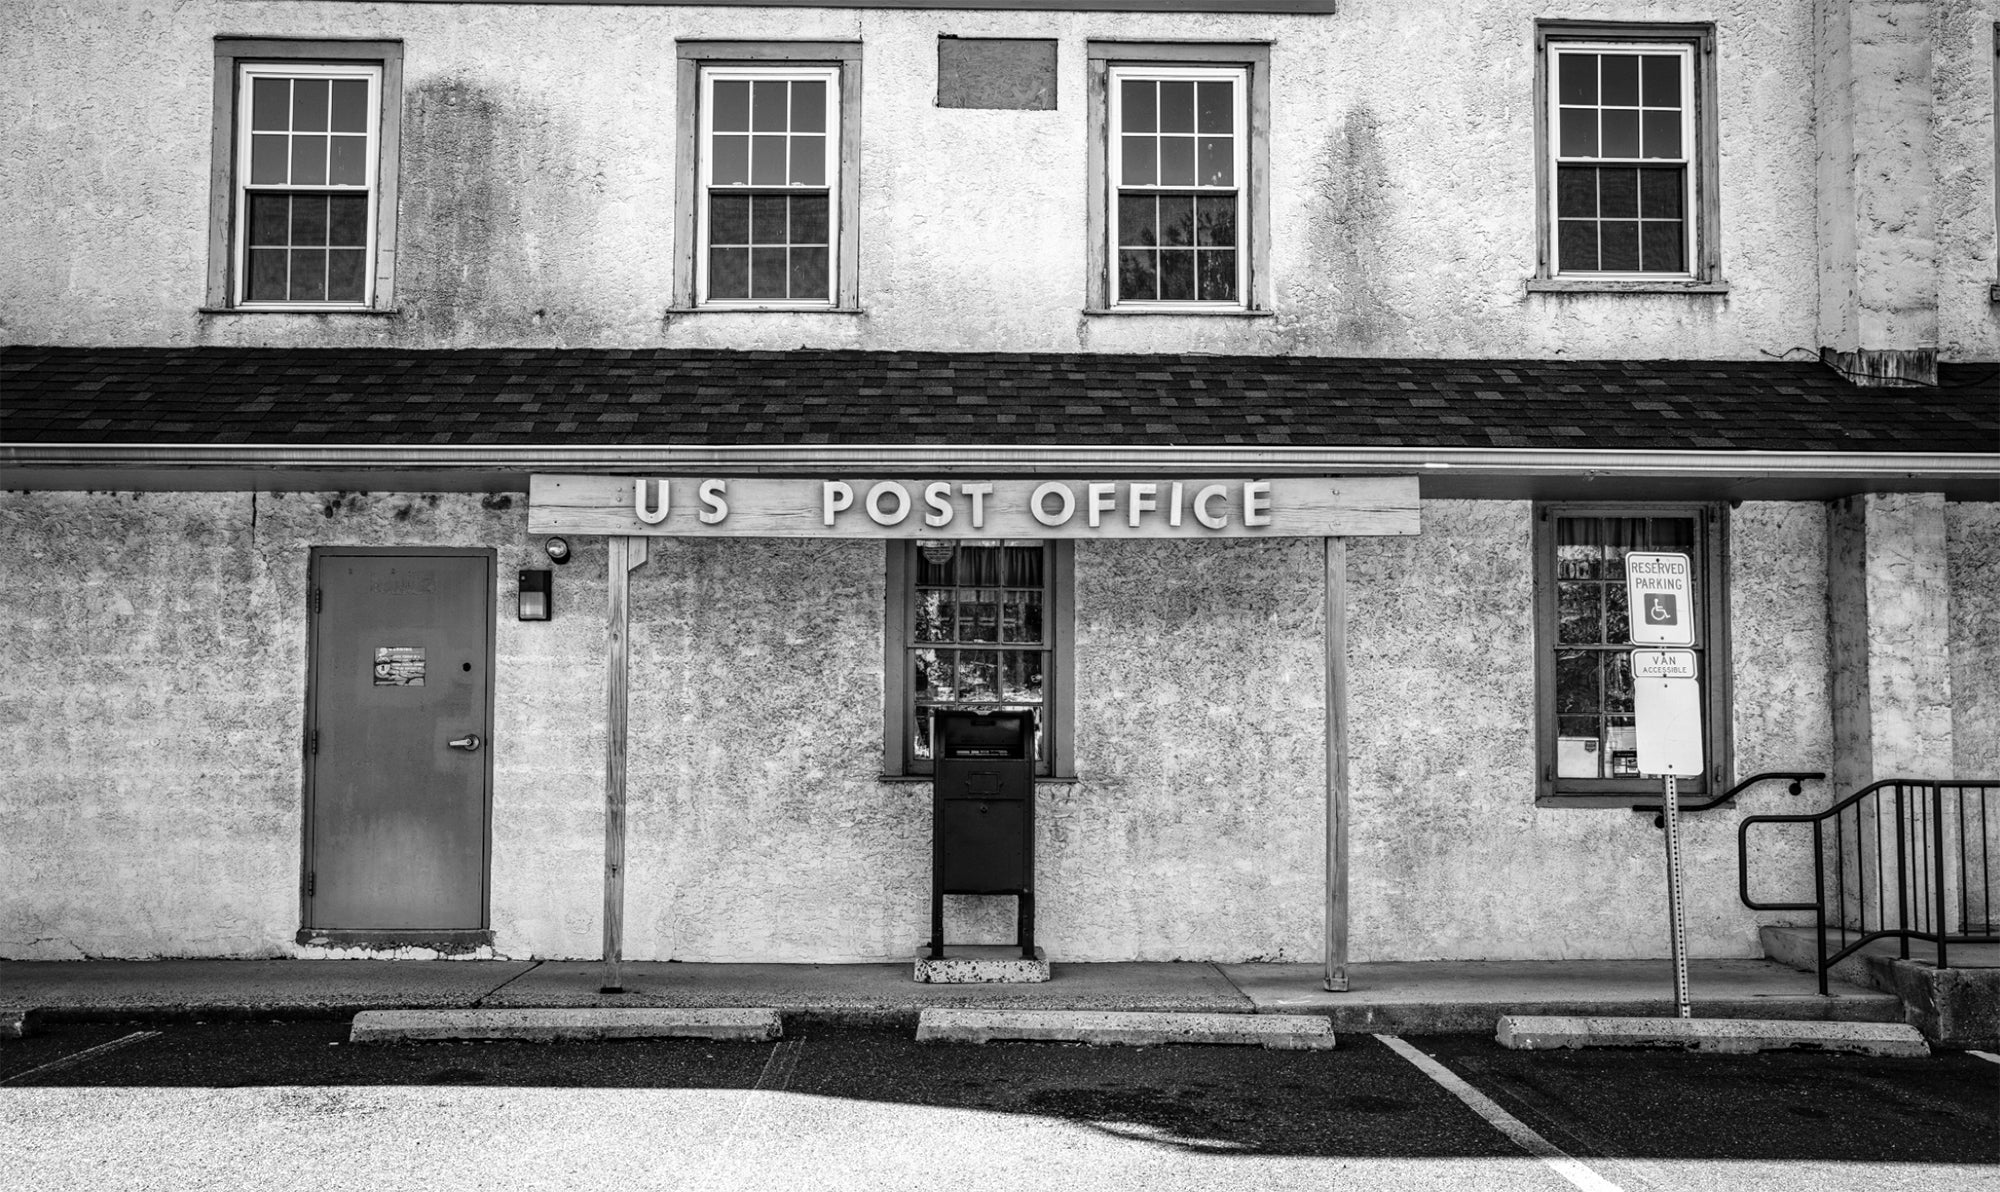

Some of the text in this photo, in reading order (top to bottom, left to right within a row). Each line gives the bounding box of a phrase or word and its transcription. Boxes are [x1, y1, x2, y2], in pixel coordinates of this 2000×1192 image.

[823, 480, 994, 528] POST
[1030, 480, 1272, 530] OFFICE
[1631, 561, 1685, 575] RESERVED
[1635, 576, 1683, 591] PARKING
[1651, 655, 1677, 666] VAN
[1642, 666, 1688, 674] ACCESSIBLE
